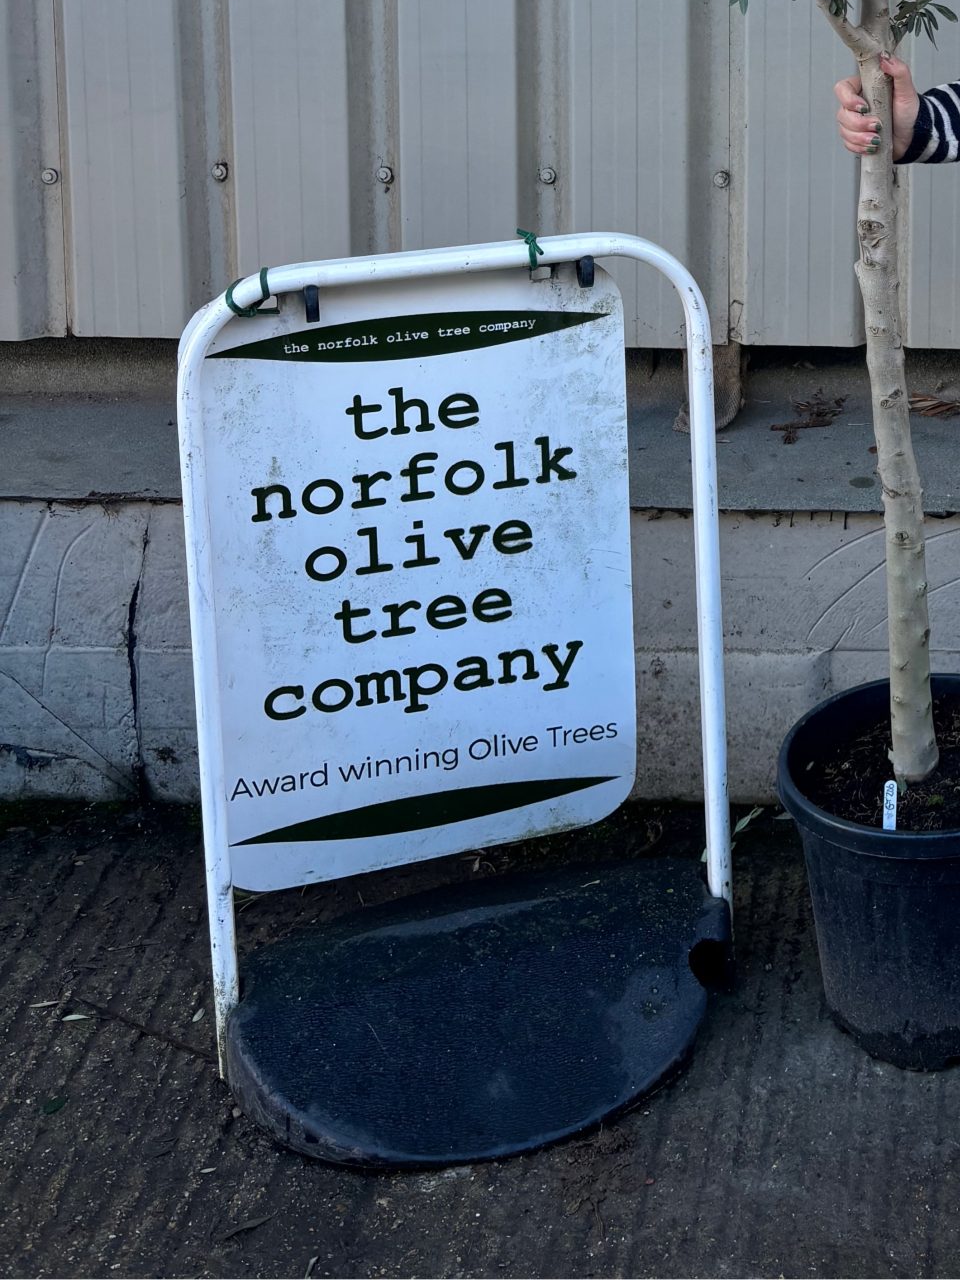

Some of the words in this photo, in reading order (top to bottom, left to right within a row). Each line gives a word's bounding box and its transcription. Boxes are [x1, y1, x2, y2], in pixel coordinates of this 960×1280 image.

[284, 343, 309, 354] the
[318, 334, 378, 351] norfolk
[386, 329, 429, 343] olive
[438, 326, 471, 337] tree
[479, 319, 537, 333] company
[346, 386, 480, 440] the
[251, 436, 577, 523] norfolk
[304, 519, 533, 582] olive
[334, 587, 513, 644] tree
[263, 640, 584, 721] company
[230, 762, 329, 802] Award
[338, 746, 459, 783] winning
[468, 733, 539, 761] Olive
[547, 722, 618, 748] Trees
